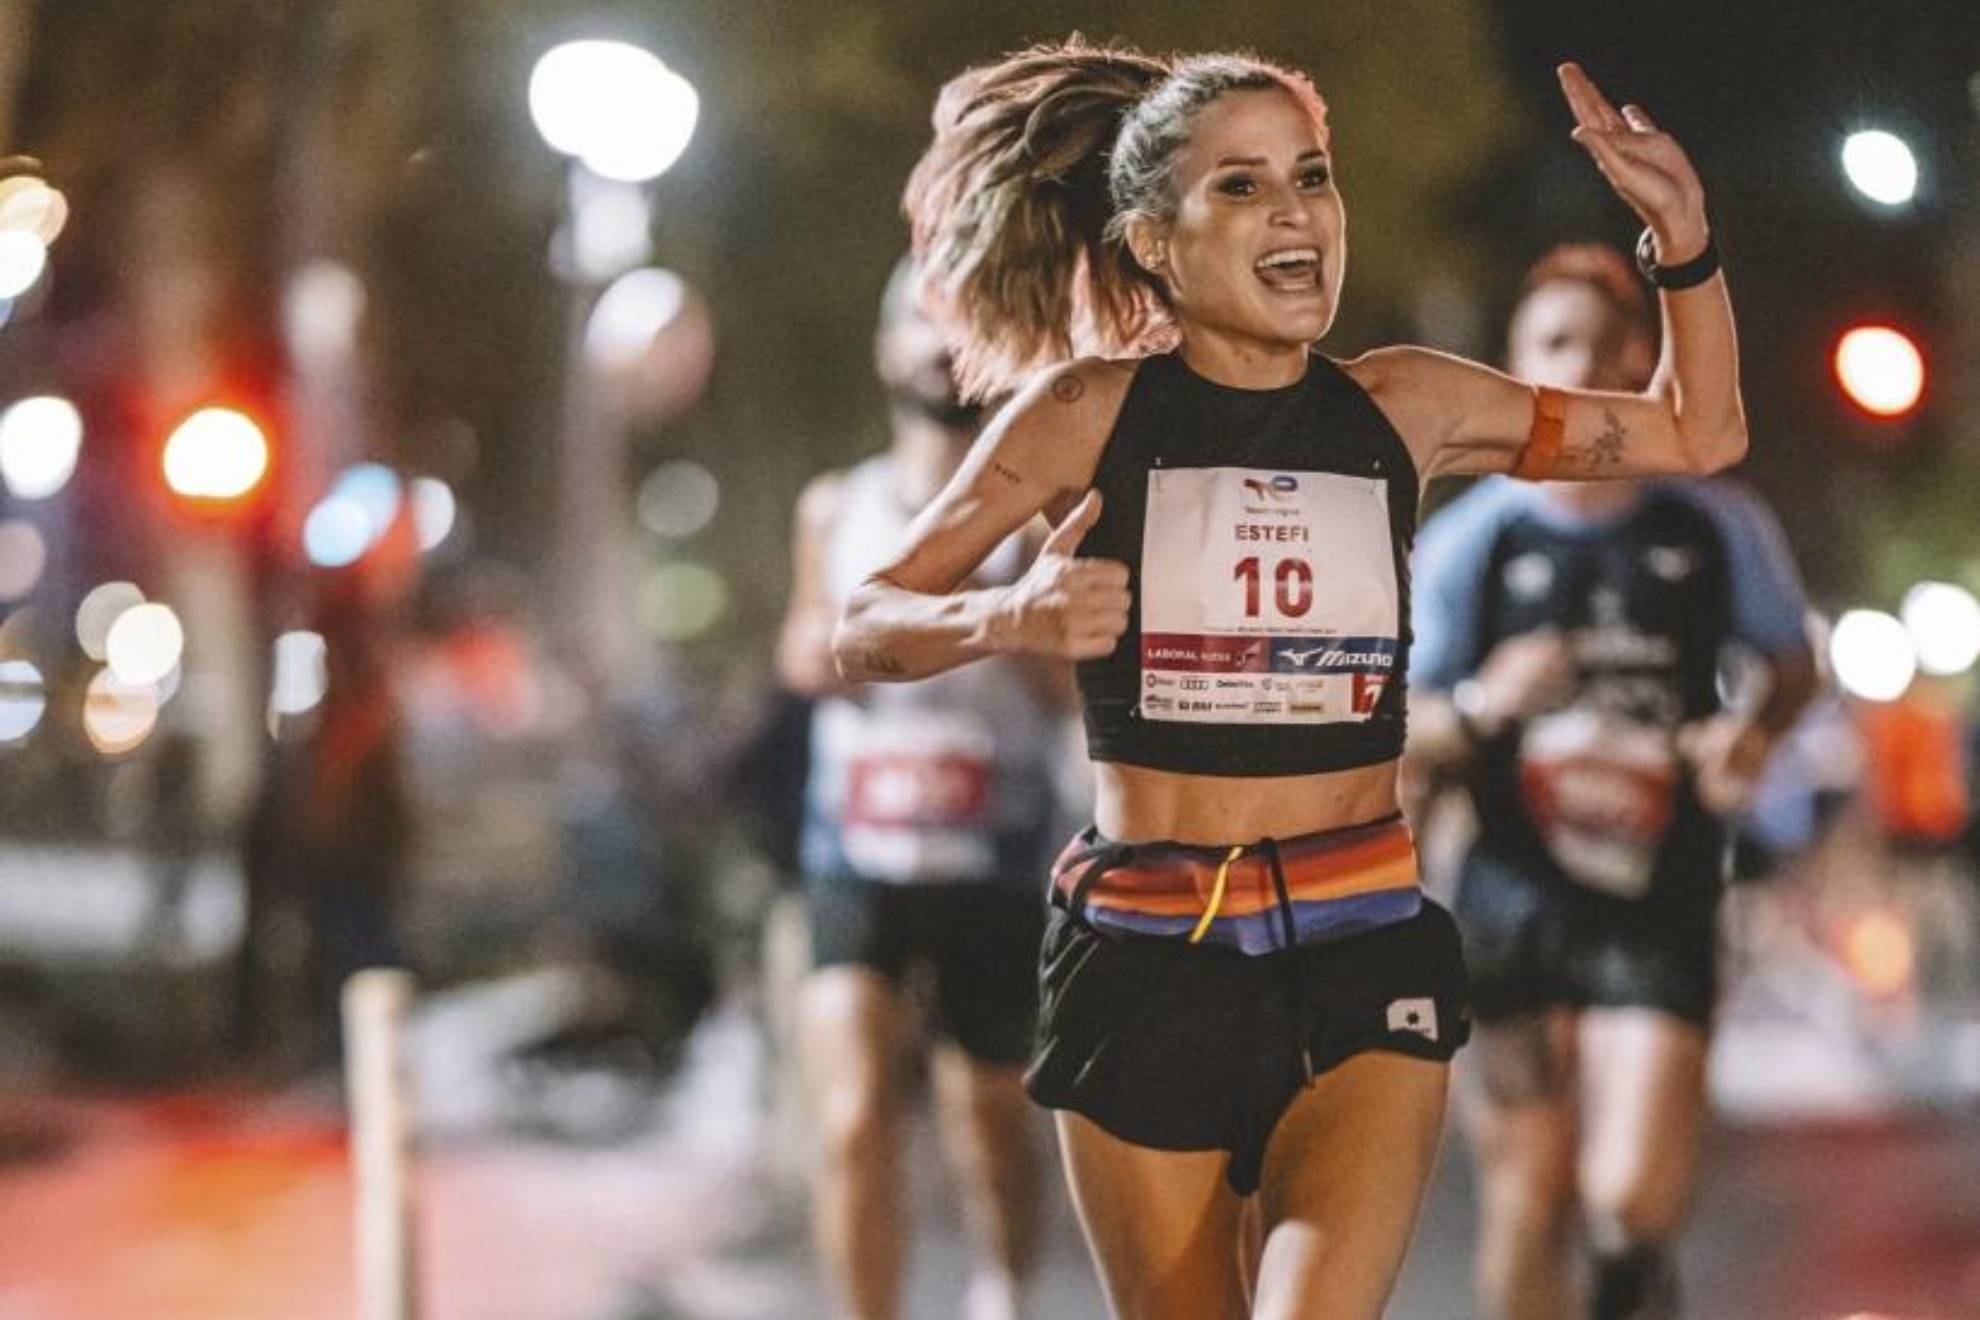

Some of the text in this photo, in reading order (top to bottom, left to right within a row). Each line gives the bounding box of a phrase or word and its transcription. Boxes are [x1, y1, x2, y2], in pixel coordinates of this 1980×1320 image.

[1235, 524, 1309, 541] ESTEFI
[1234, 556, 1313, 618] 10
[1147, 648, 1198, 660] LABORAL
